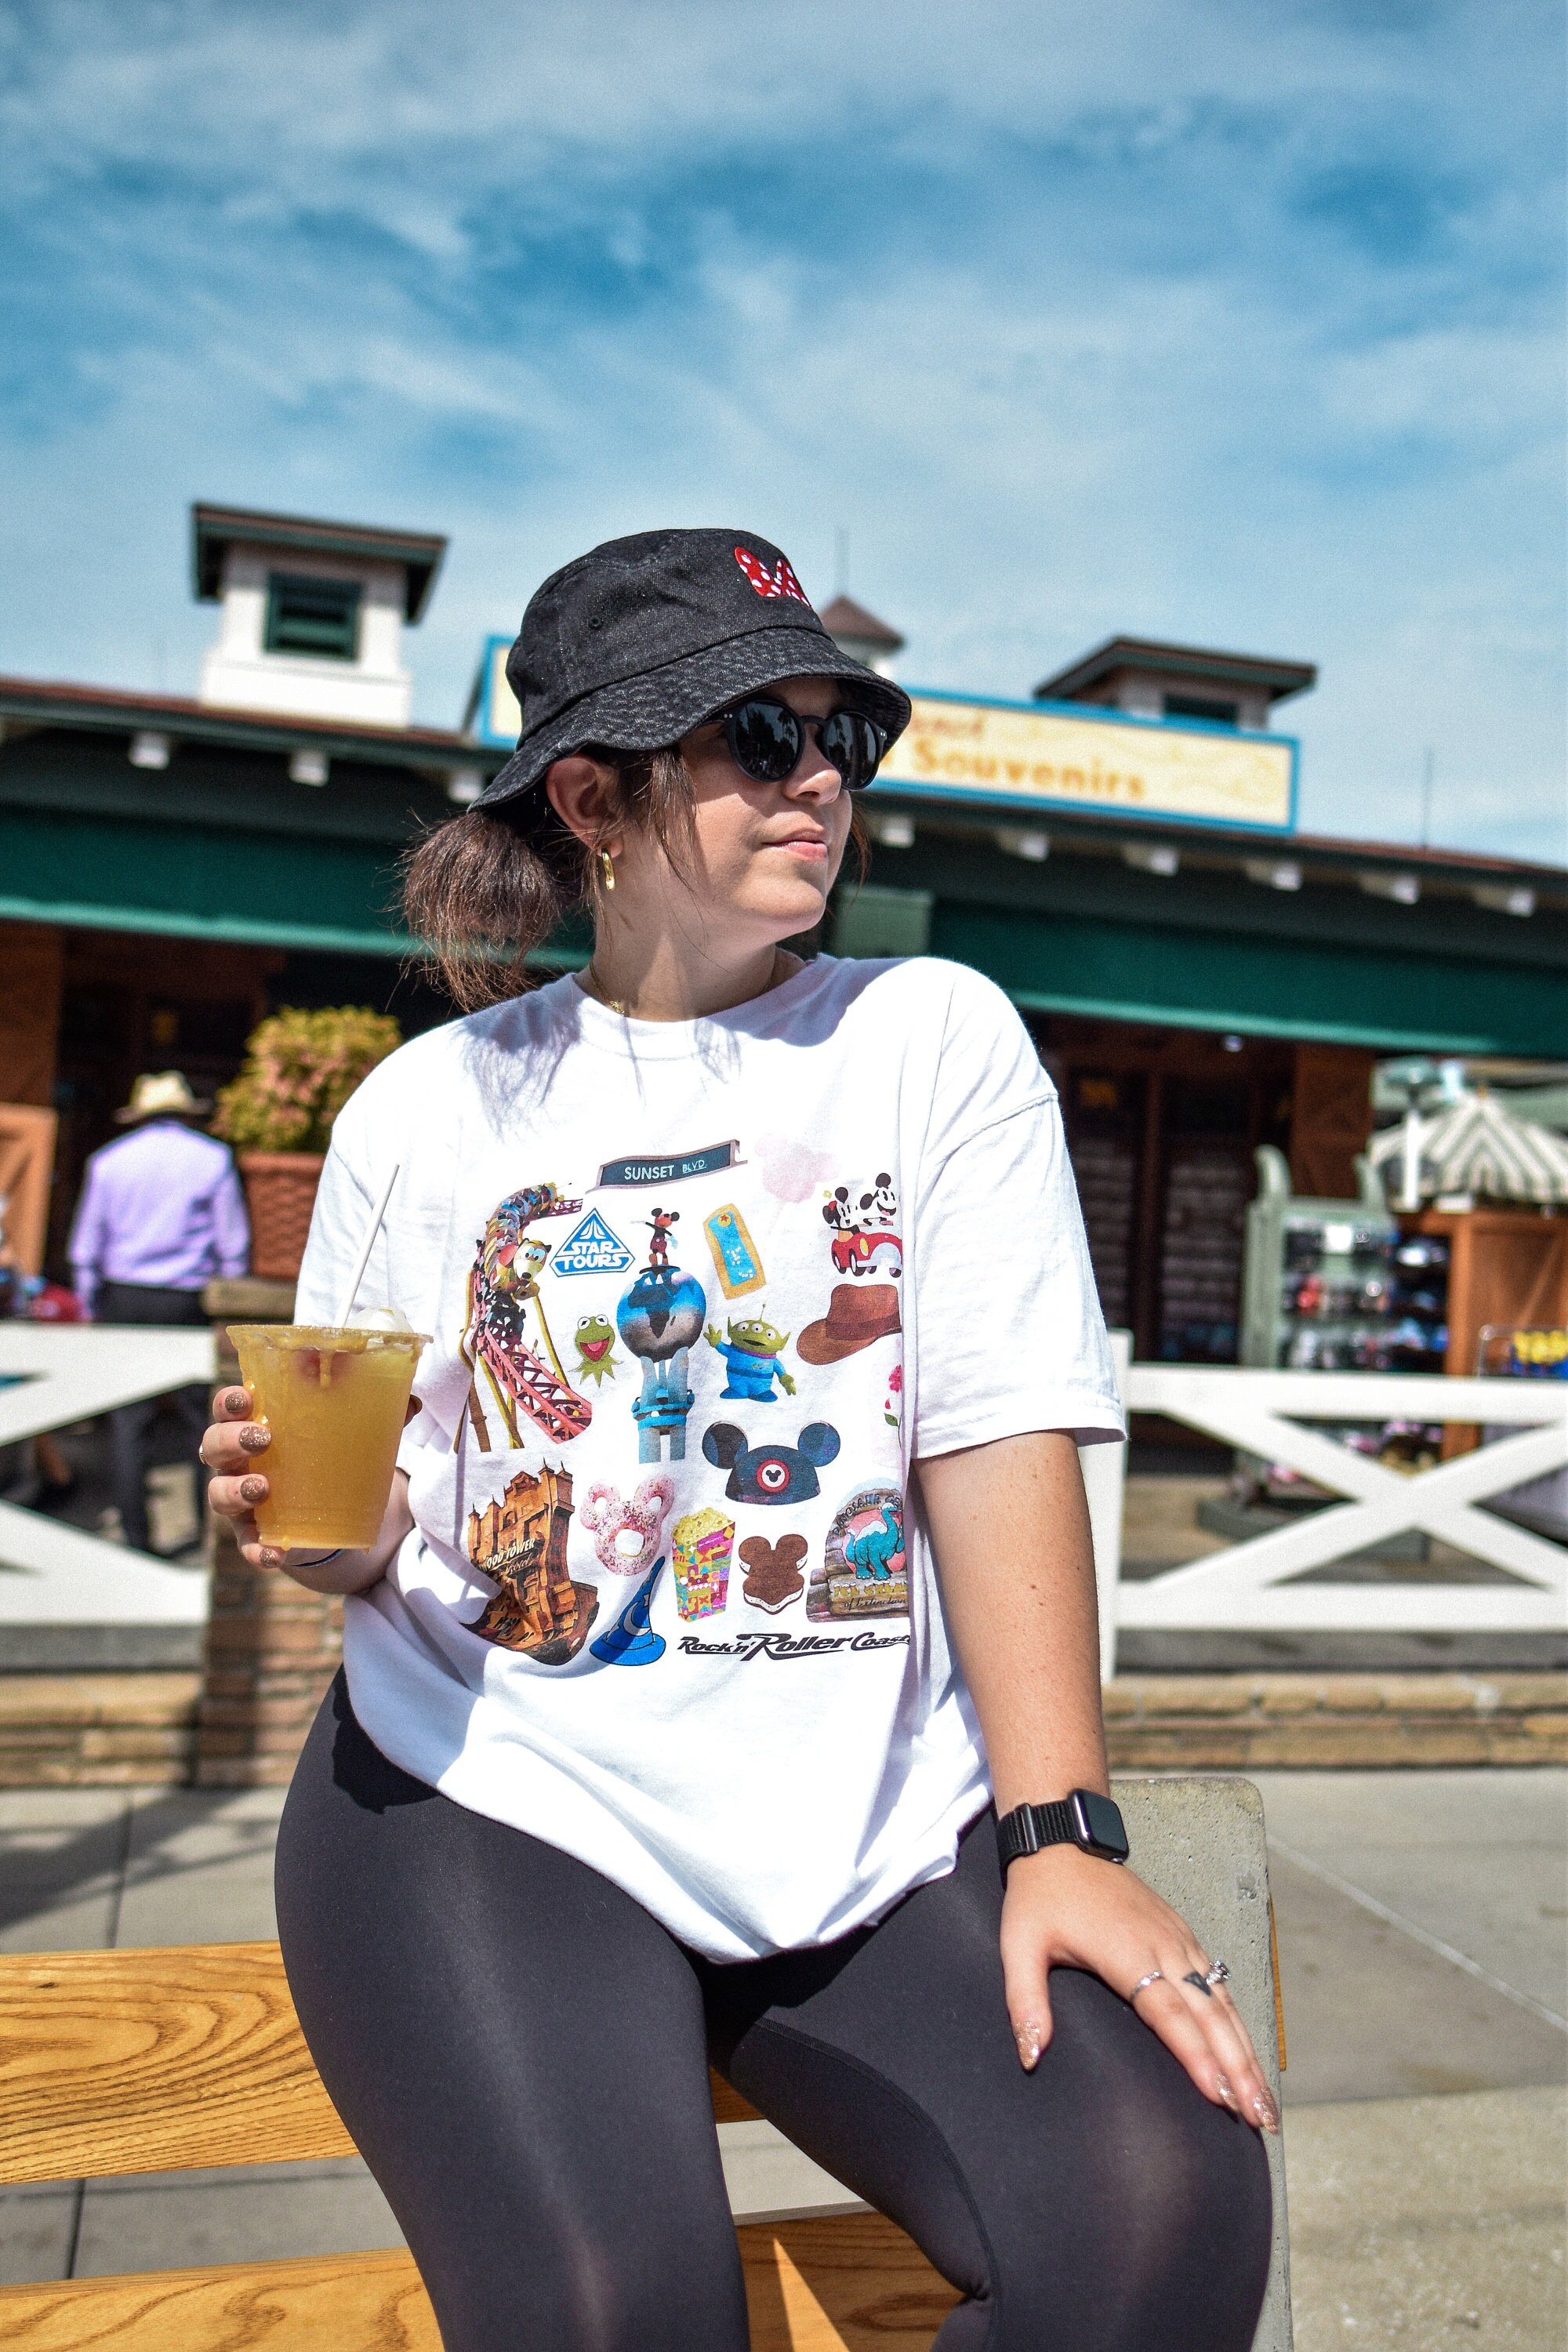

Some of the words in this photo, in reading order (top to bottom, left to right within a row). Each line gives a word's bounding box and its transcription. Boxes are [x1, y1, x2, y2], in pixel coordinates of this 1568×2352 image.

[912, 737, 1145, 800] Souvenirs
[624, 1165, 675, 1181] SUNSET
[564, 1241, 626, 1254] STAR
[556, 1253, 626, 1270] TOURS
[505, 1537, 535, 1559] TOWER
[833, 1582, 860, 1596] ICE
[844, 1597, 855, 1610] of
[856, 1596, 906, 1606] Extinction
